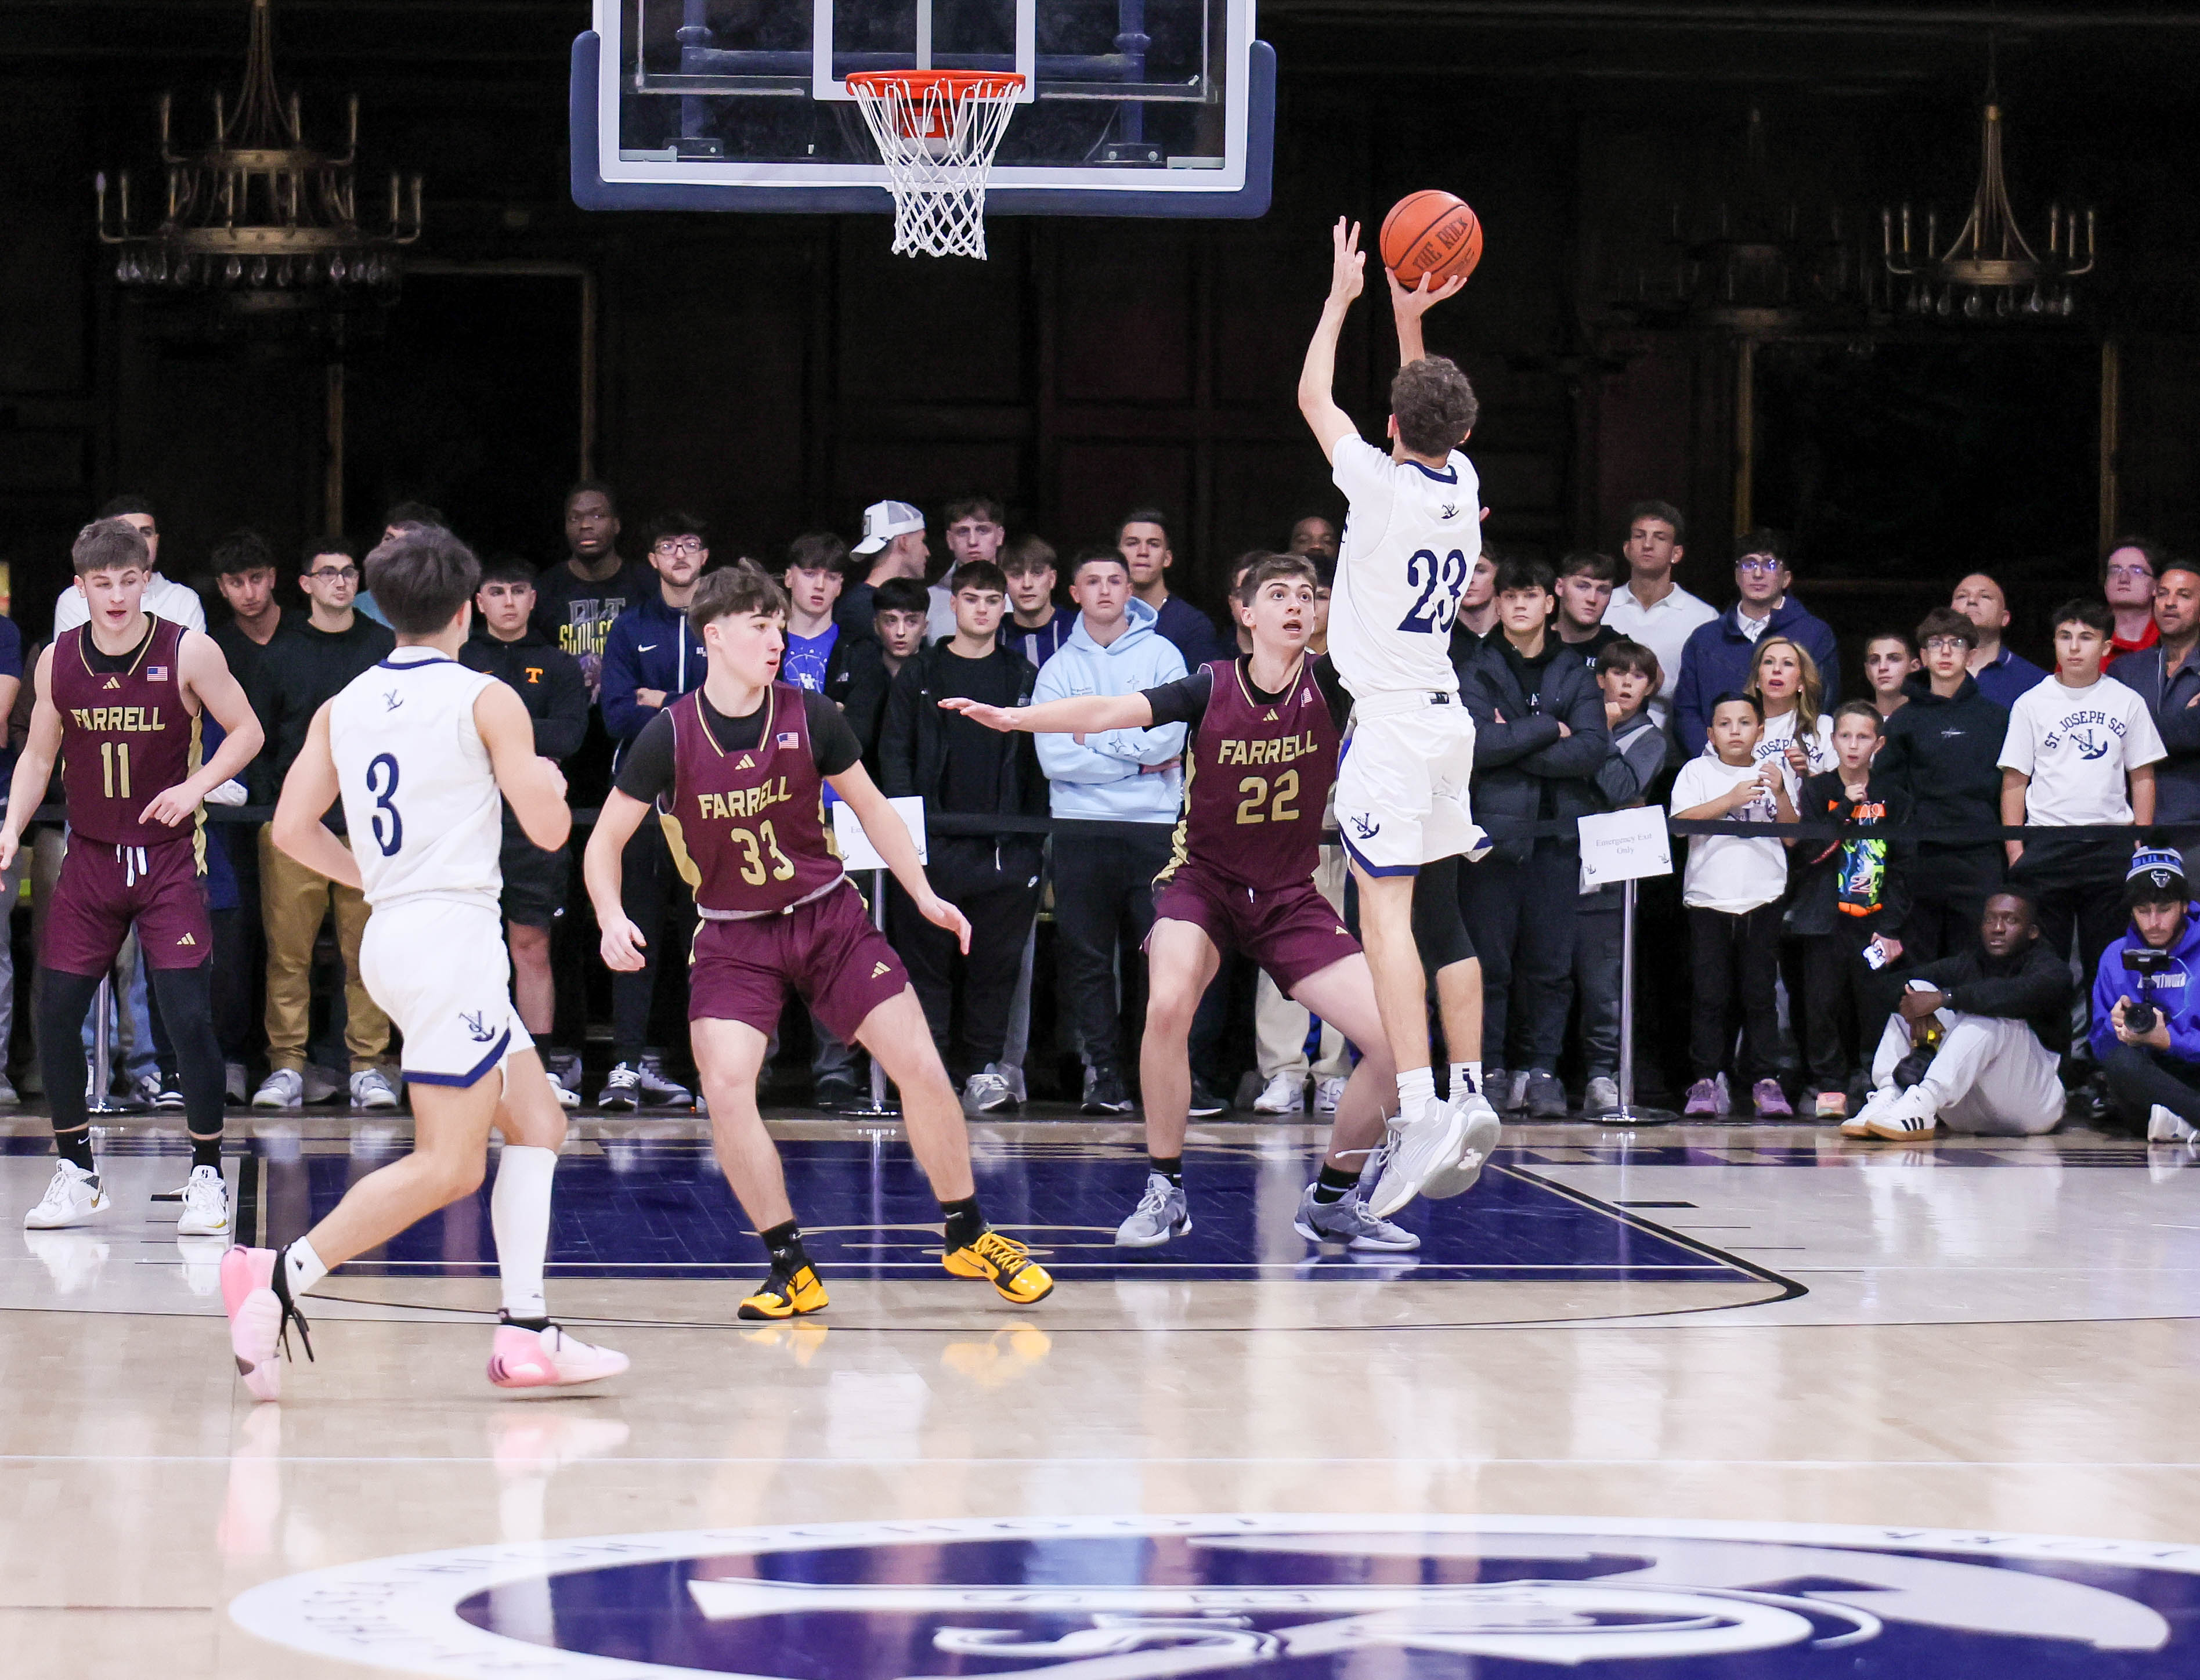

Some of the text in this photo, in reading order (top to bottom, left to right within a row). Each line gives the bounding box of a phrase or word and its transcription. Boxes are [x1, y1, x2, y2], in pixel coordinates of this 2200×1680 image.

[1396, 548, 1467, 634] 23
[525, 667, 543, 683] T
[70, 706, 166, 732] FARRELL
[2058, 710, 2106, 732] JOSEPH
[1218, 730, 1318, 765] FARRELL
[100, 742, 131, 799] 11
[366, 752, 403, 857] 3
[698, 775, 793, 821] FARRELL
[1236, 769, 1300, 825] 22
[730, 819, 796, 886] 33
[1596, 835, 1635, 847] Emergency
[1617, 846, 1634, 854] Only
